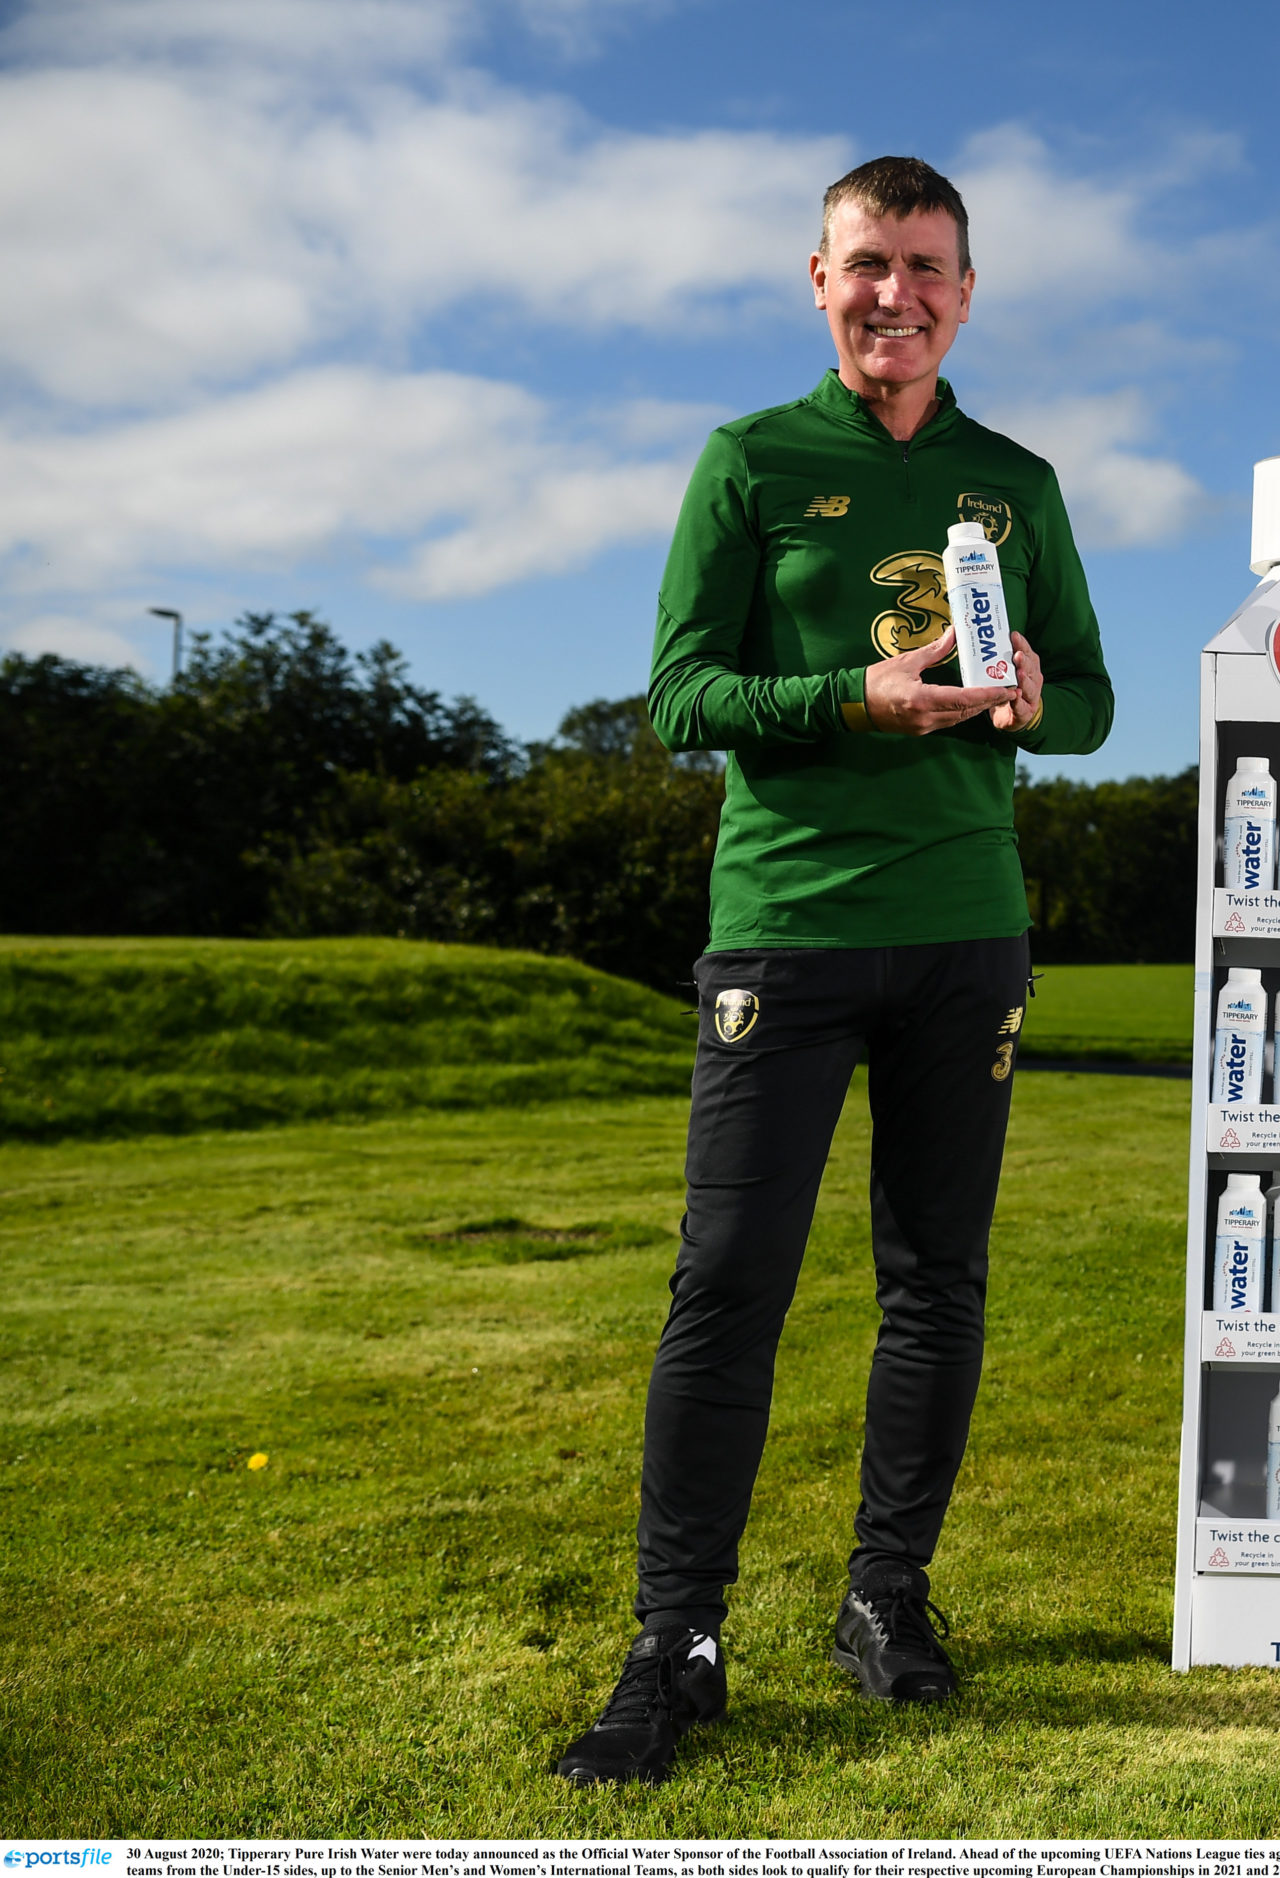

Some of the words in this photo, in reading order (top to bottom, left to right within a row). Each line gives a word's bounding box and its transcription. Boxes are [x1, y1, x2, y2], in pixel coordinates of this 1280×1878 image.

[967, 498, 1002, 514] Ireland
[955, 563, 995, 574] TIPPERARY
[971, 588, 998, 662] water
[1237, 799, 1271, 807] TIPPERARY
[1242, 821, 1261, 889] water
[1226, 894, 1259, 907] Twist
[1223, 1012, 1258, 1020] TIPPERARY
[1226, 1034, 1246, 1102] water
[1221, 1111, 1254, 1122] Twist
[1259, 1111, 1280, 1123] the
[1224, 1219, 1259, 1227] TIPPERARY
[1229, 1240, 1248, 1309] water
[1216, 1320, 1249, 1332] Twist
[1254, 1320, 1276, 1332] the
[1210, 1530, 1243, 1542] Twist
[1248, 1531, 1269, 1543] the
